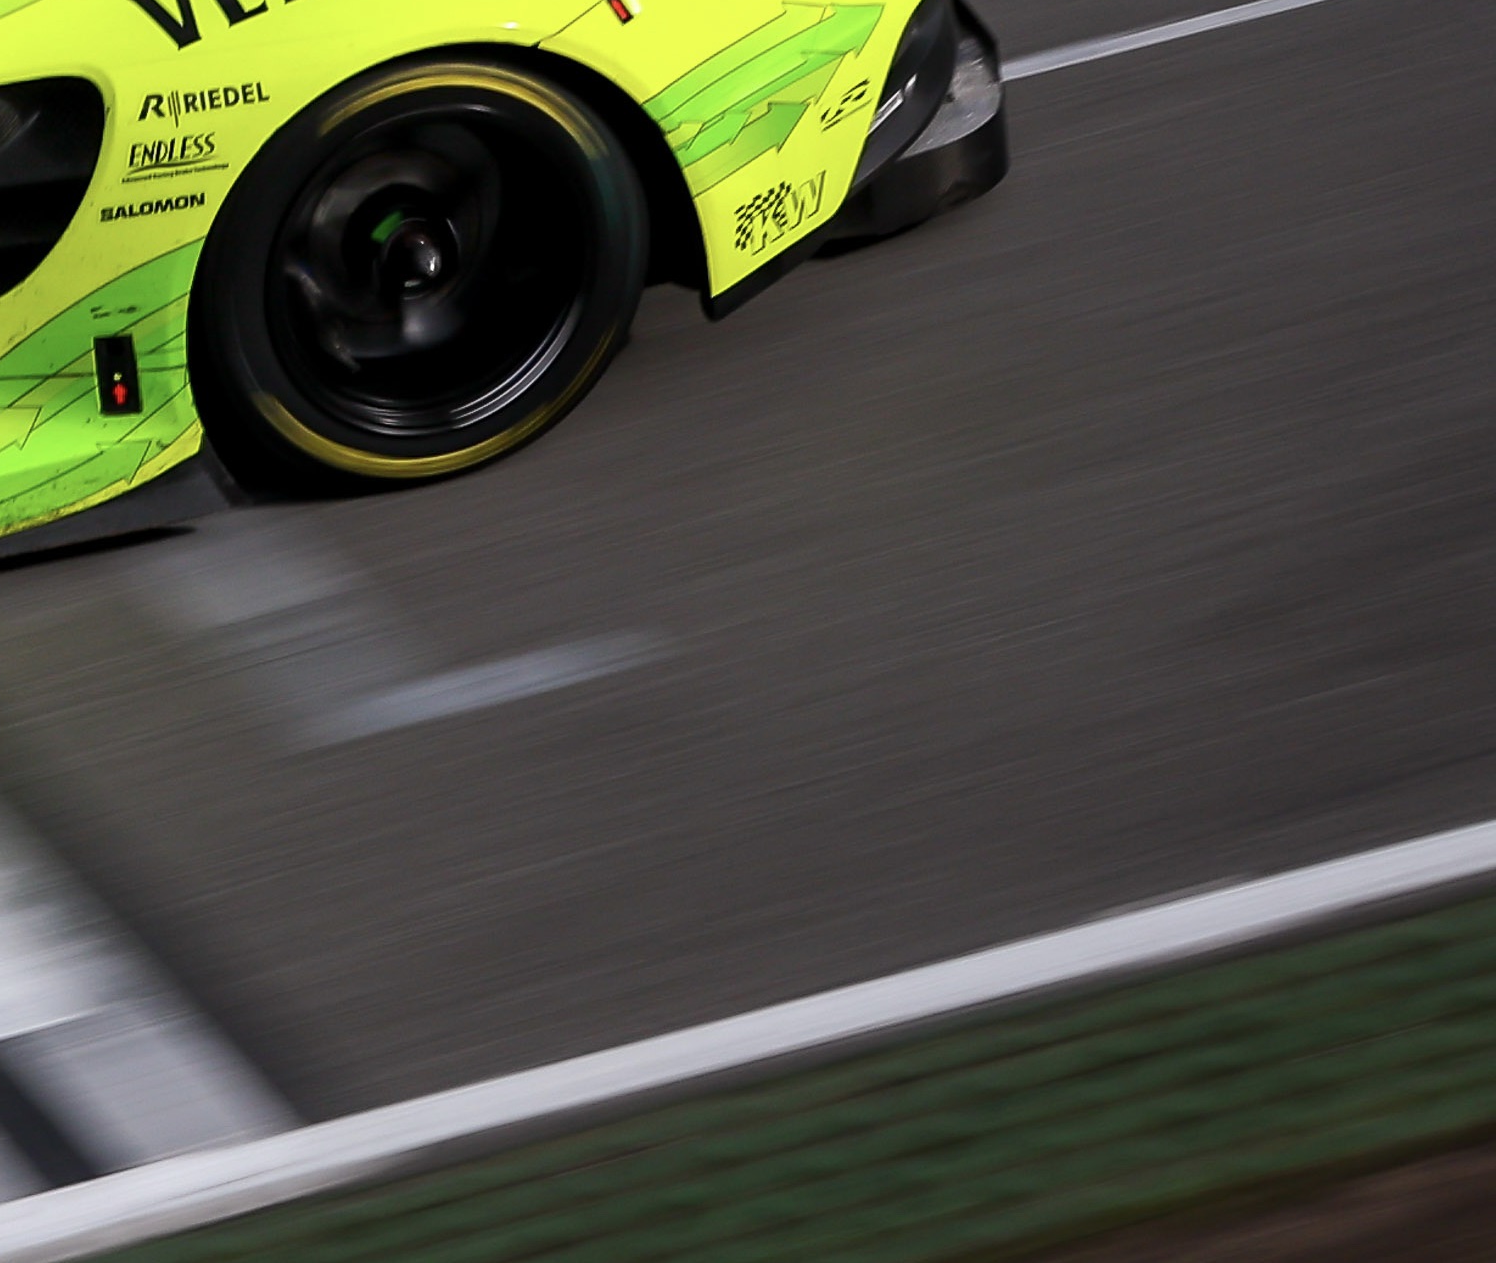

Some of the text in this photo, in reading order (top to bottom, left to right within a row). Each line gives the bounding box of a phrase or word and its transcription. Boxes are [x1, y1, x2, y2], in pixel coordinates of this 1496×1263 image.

[184, 81, 271, 115] RIEDEL
[128, 131, 216, 168] ENDLESS
[99, 192, 206, 222] SALOMON
